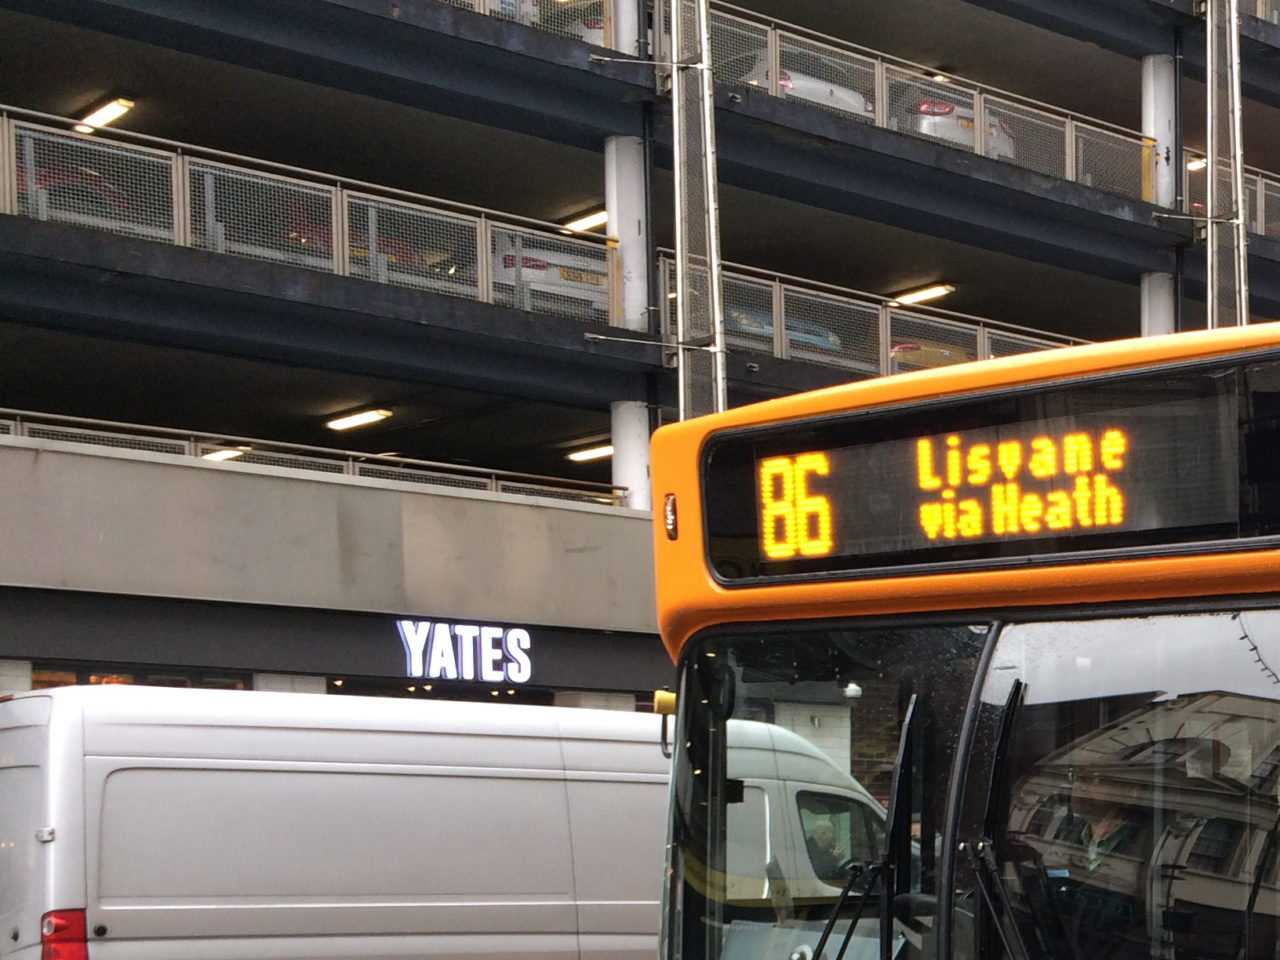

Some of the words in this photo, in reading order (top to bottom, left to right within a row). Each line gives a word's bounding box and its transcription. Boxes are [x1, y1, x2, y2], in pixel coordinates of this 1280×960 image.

[916, 428, 1128, 489] Lisvane
[758, 451, 833, 560] 86
[919, 490, 983, 540] via
[991, 473, 1125, 536] Heath
[396, 619, 532, 683] YATES
